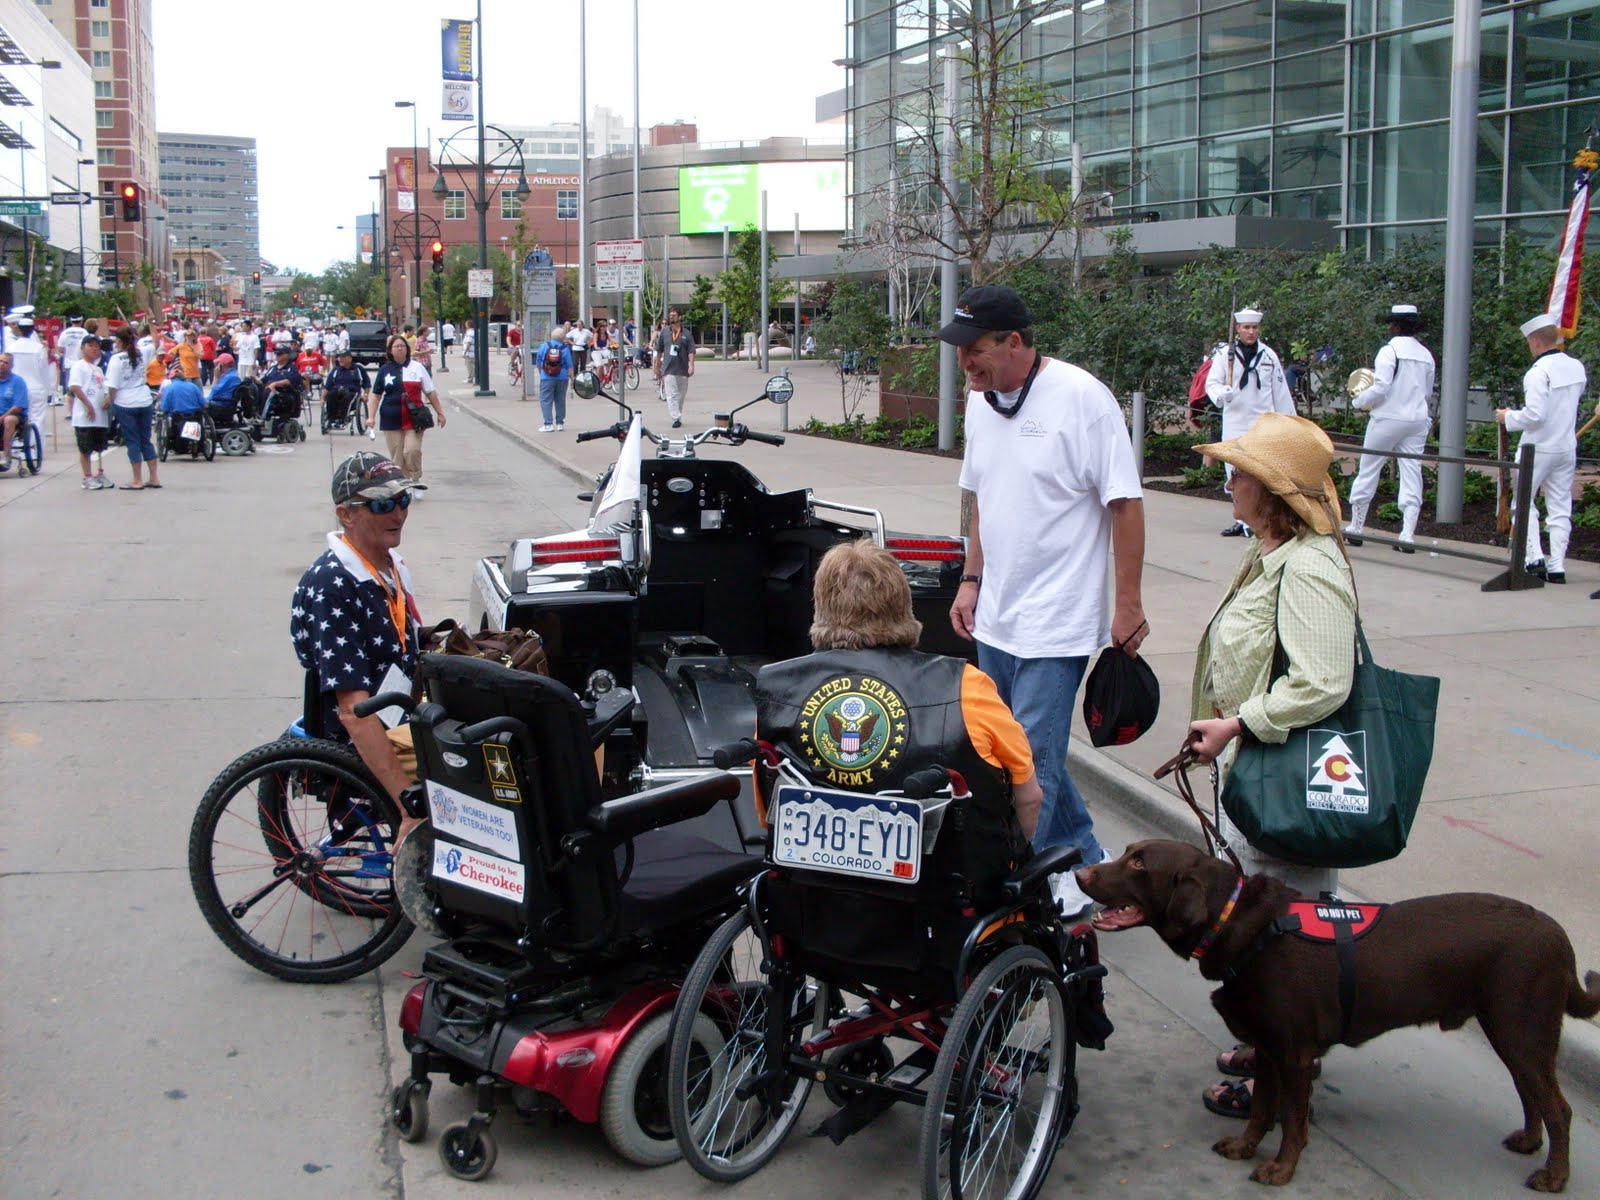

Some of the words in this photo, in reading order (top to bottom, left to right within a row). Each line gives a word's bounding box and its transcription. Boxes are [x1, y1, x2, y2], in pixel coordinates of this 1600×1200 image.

[457, 23, 472, 72] DENVER
[444, 83, 470, 91] WELCOME
[499, 176, 531, 184] DENVR
[533, 176, 570, 184] ATHLETIC
[802, 677, 852, 717] UNITED
[860, 678, 906, 719] STATES
[826, 767, 875, 786] ARMY
[505, 789, 518, 799] ARMY
[1309, 792, 1366, 806] COLORADO
[461, 804, 488, 820] WOMEN
[489, 815, 505, 828] ARE
[1332, 803, 1368, 812] PRODUCTS
[458, 815, 495, 836] VETERANS
[468, 855, 496, 870] Proud
[508, 867, 518, 876] be
[812, 852, 882, 871] COLORADO
[895, 863, 906, 873] 11
[459, 863, 523, 895] Cherokee
[1317, 908, 1329, 918] DO
[1329, 908, 1345, 919] NOT
[1345, 909, 1361, 919] PET
